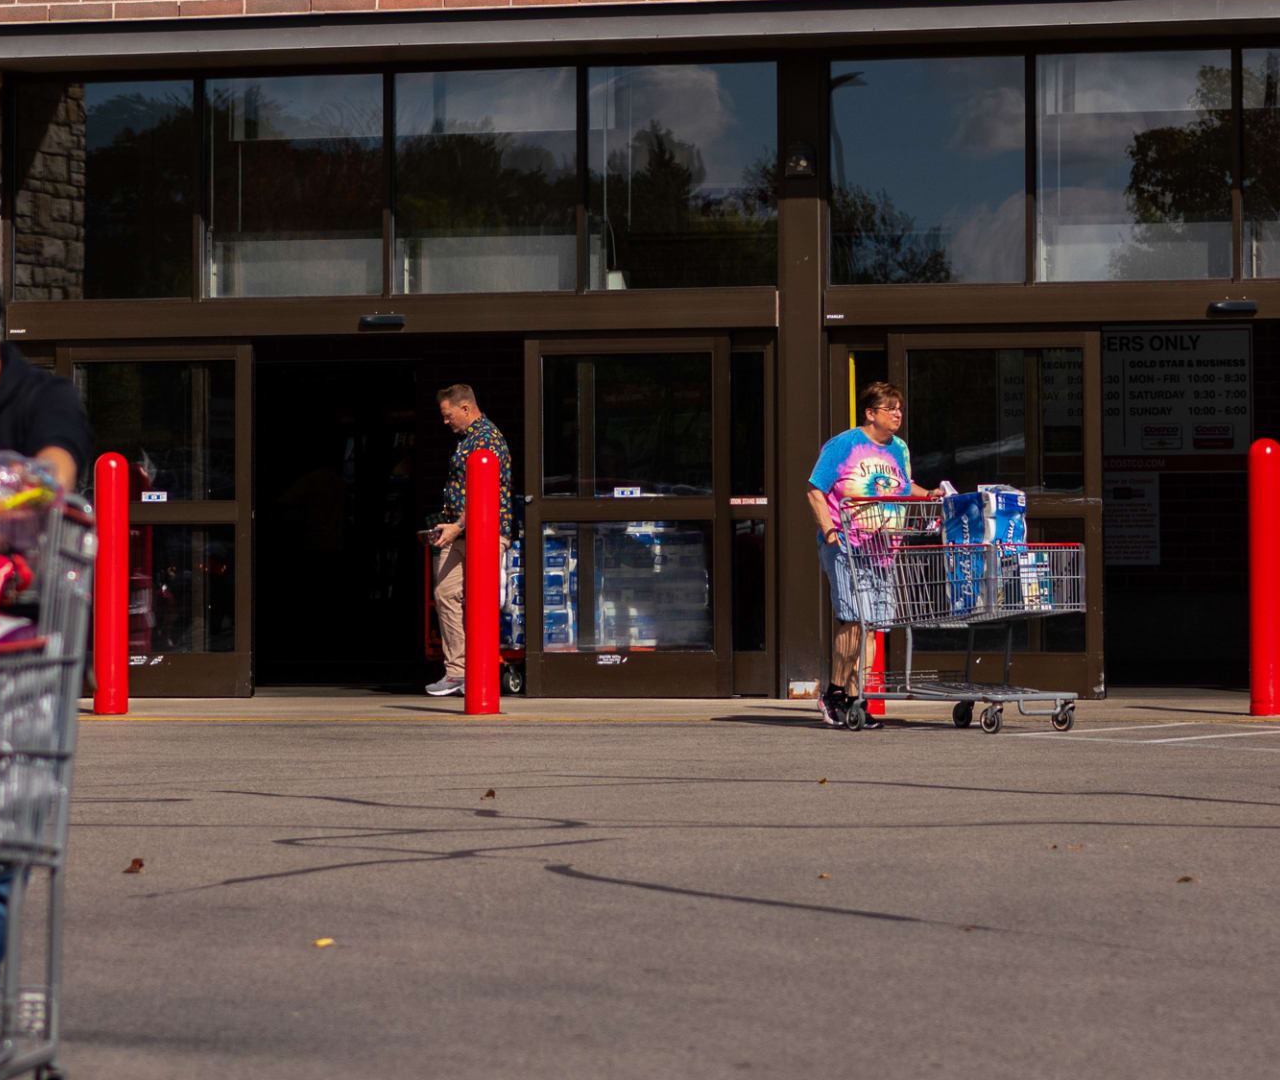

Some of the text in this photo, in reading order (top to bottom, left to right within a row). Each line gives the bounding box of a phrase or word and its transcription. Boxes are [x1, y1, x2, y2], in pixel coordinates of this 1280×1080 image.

[1103, 335, 1200, 352] ERS ONLY
[1129, 360, 1157, 369] GOLD
[1159, 360, 1186, 368] STAR
[1196, 359, 1246, 368] BUSINESS
[1129, 375, 1155, 384] MON
[1163, 375, 1180, 384] FRI
[1188, 374, 1215, 383] 10:00
[1129, 390, 1185, 400] SATURDAY
[1225, 390, 1247, 399] 7:00
[1129, 407, 1172, 416] SUNDAY
[1188, 406, 1216, 416] 10:00
